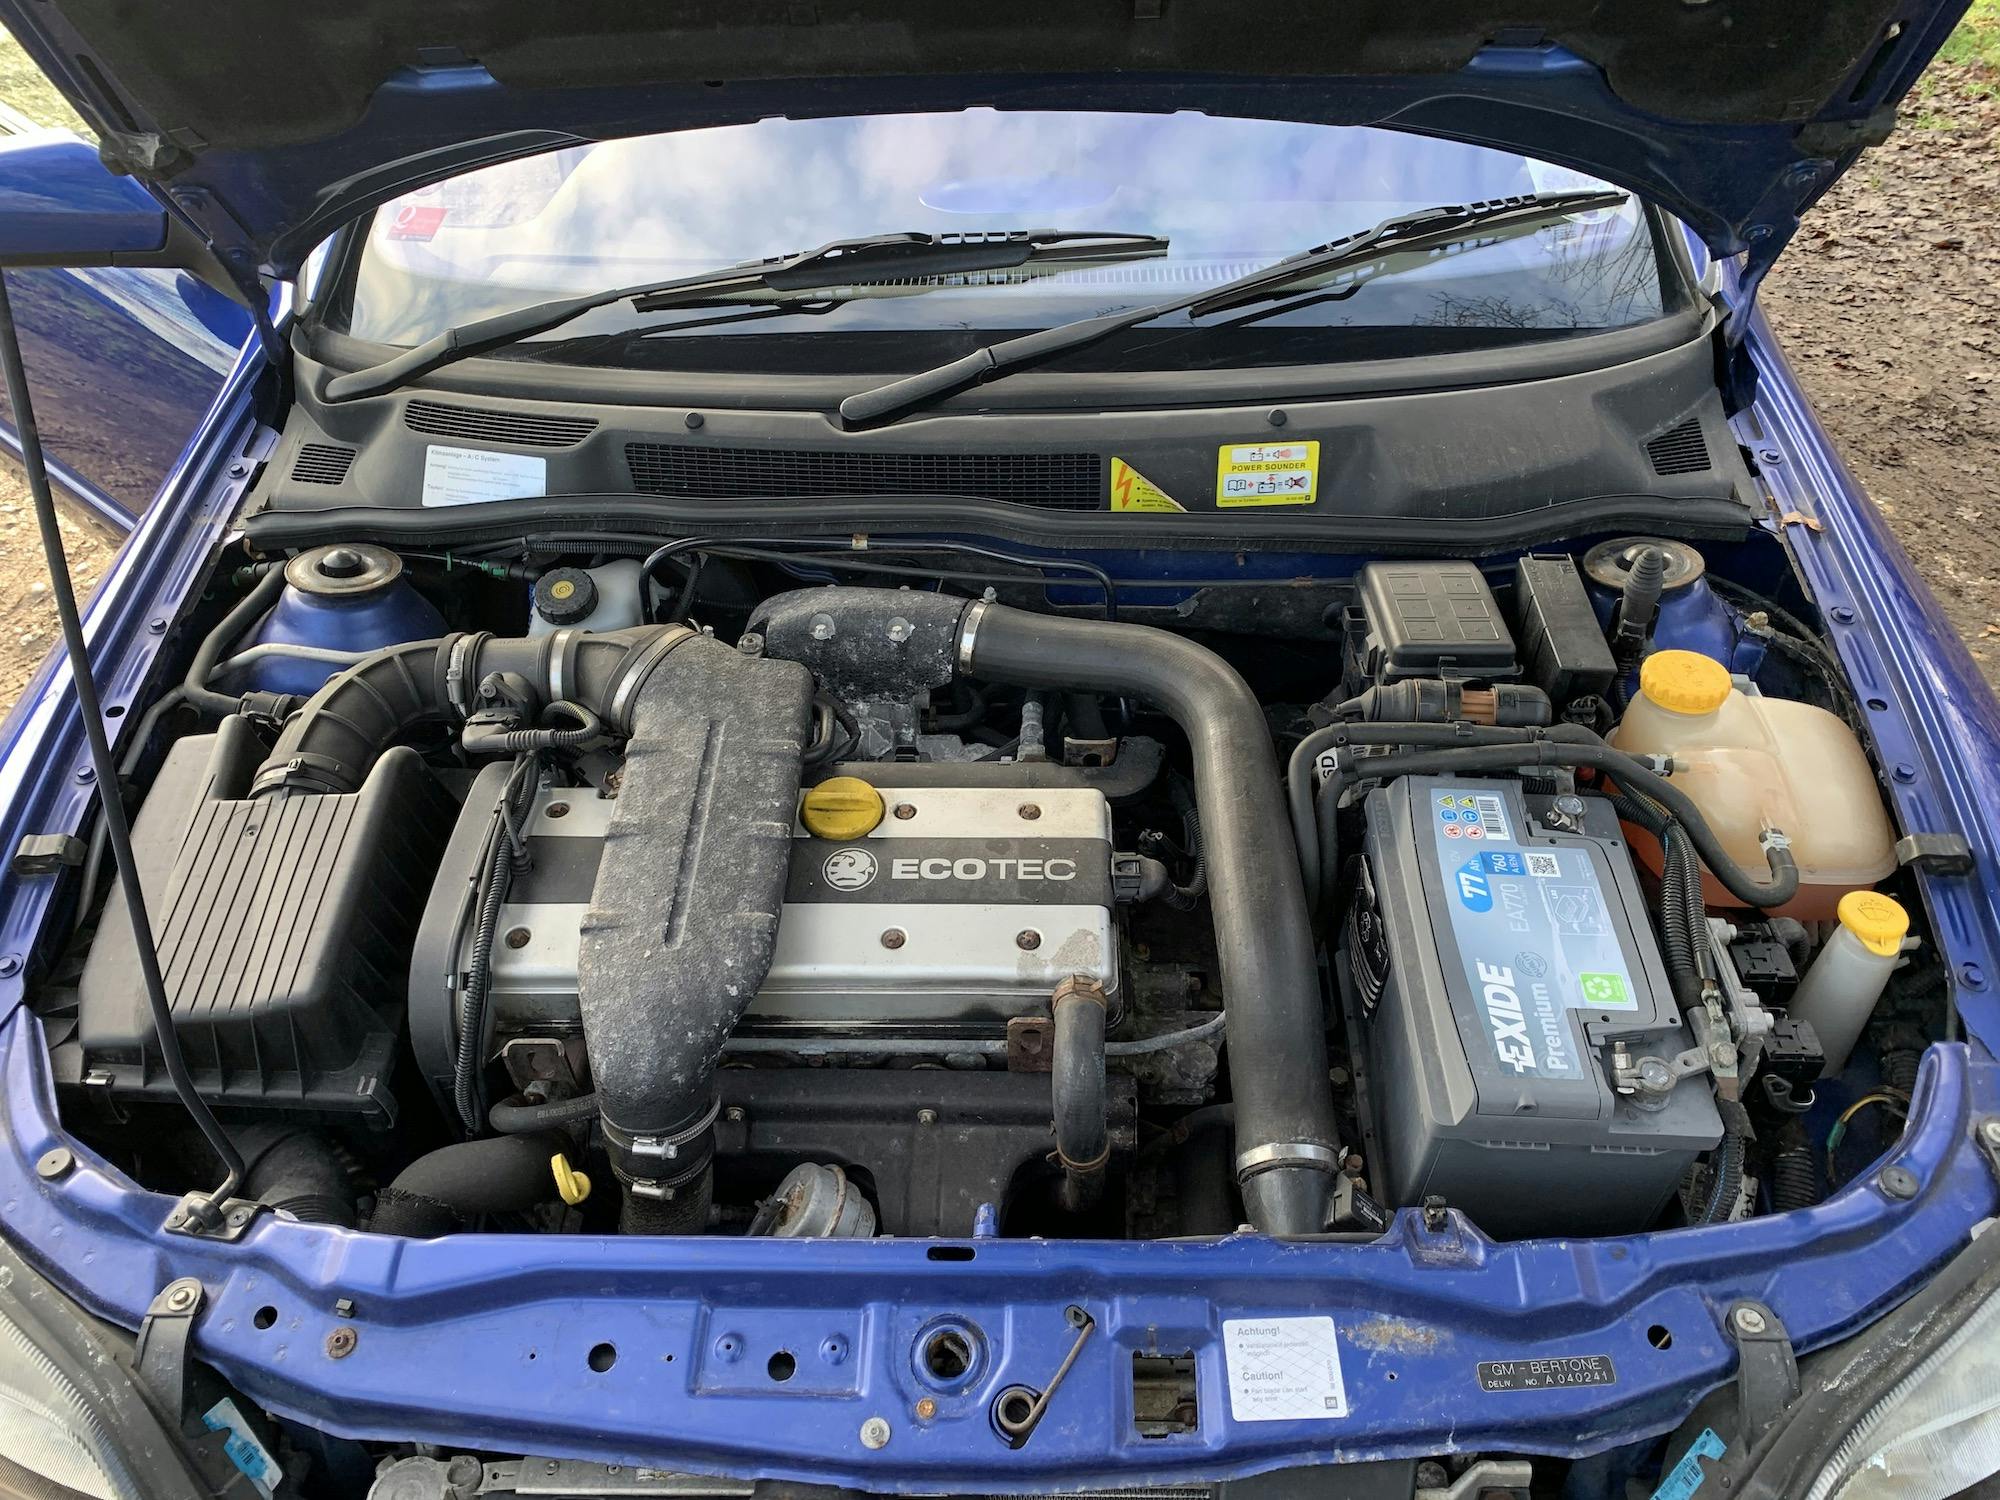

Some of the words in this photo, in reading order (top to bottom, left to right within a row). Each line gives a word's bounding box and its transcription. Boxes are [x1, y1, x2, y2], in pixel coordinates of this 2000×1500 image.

[1231, 464, 1262, 472] POWER
[1265, 462, 1306, 471] SOUNDER
[891, 858, 1077, 881] ECOTEC
[1469, 859, 1481, 872] Ah
[1491, 854, 1508, 873] 760
[1458, 872, 1488, 898] 77
[1500, 883, 1531, 932] EA770
[1475, 960, 1537, 1073] EXIDE
[1530, 982, 1569, 1070] Premium
[1237, 1326, 1280, 1337] Achtung!
[1242, 1370, 1284, 1381] Caution!
[1491, 1363, 1515, 1376] GM
[1530, 1357, 1602, 1374] BERTONE
[1488, 1380, 1514, 1388] DELIV.
